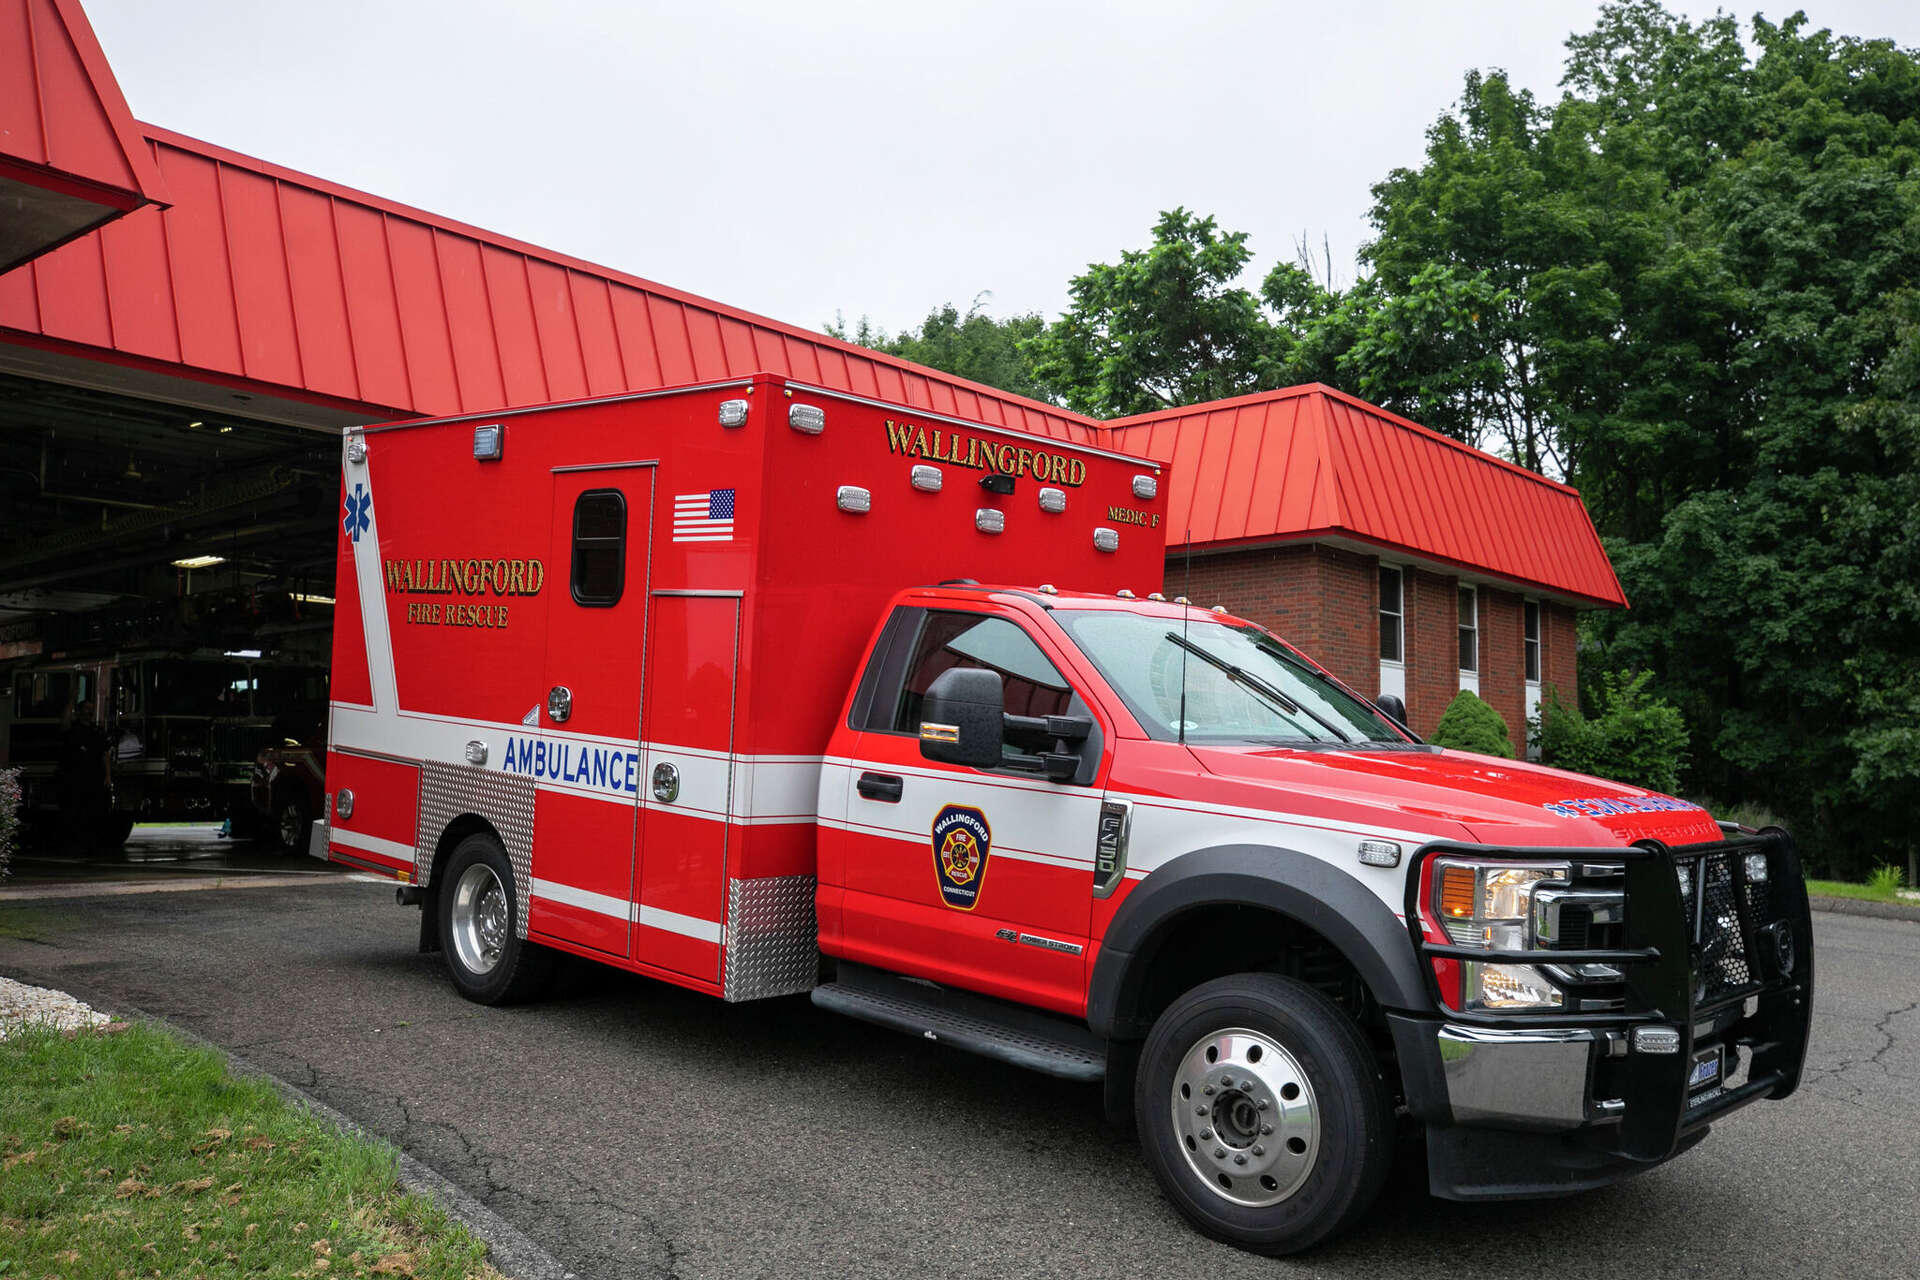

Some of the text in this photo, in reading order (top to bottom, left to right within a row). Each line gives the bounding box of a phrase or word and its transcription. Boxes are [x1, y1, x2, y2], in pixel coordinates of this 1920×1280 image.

[884, 419, 1087, 488] WALLINGFORD
[1108, 505, 1147, 527] MEDIC
[385, 557, 545, 597] WALLINGFORD
[407, 602, 509, 629] FIRE RESCUE
[503, 736, 640, 792] AMBULANCE
[935, 813, 989, 842] WALLINGFORD
[955, 833, 967, 842] FIRE
[943, 885, 976, 898] CONNECTICUT
